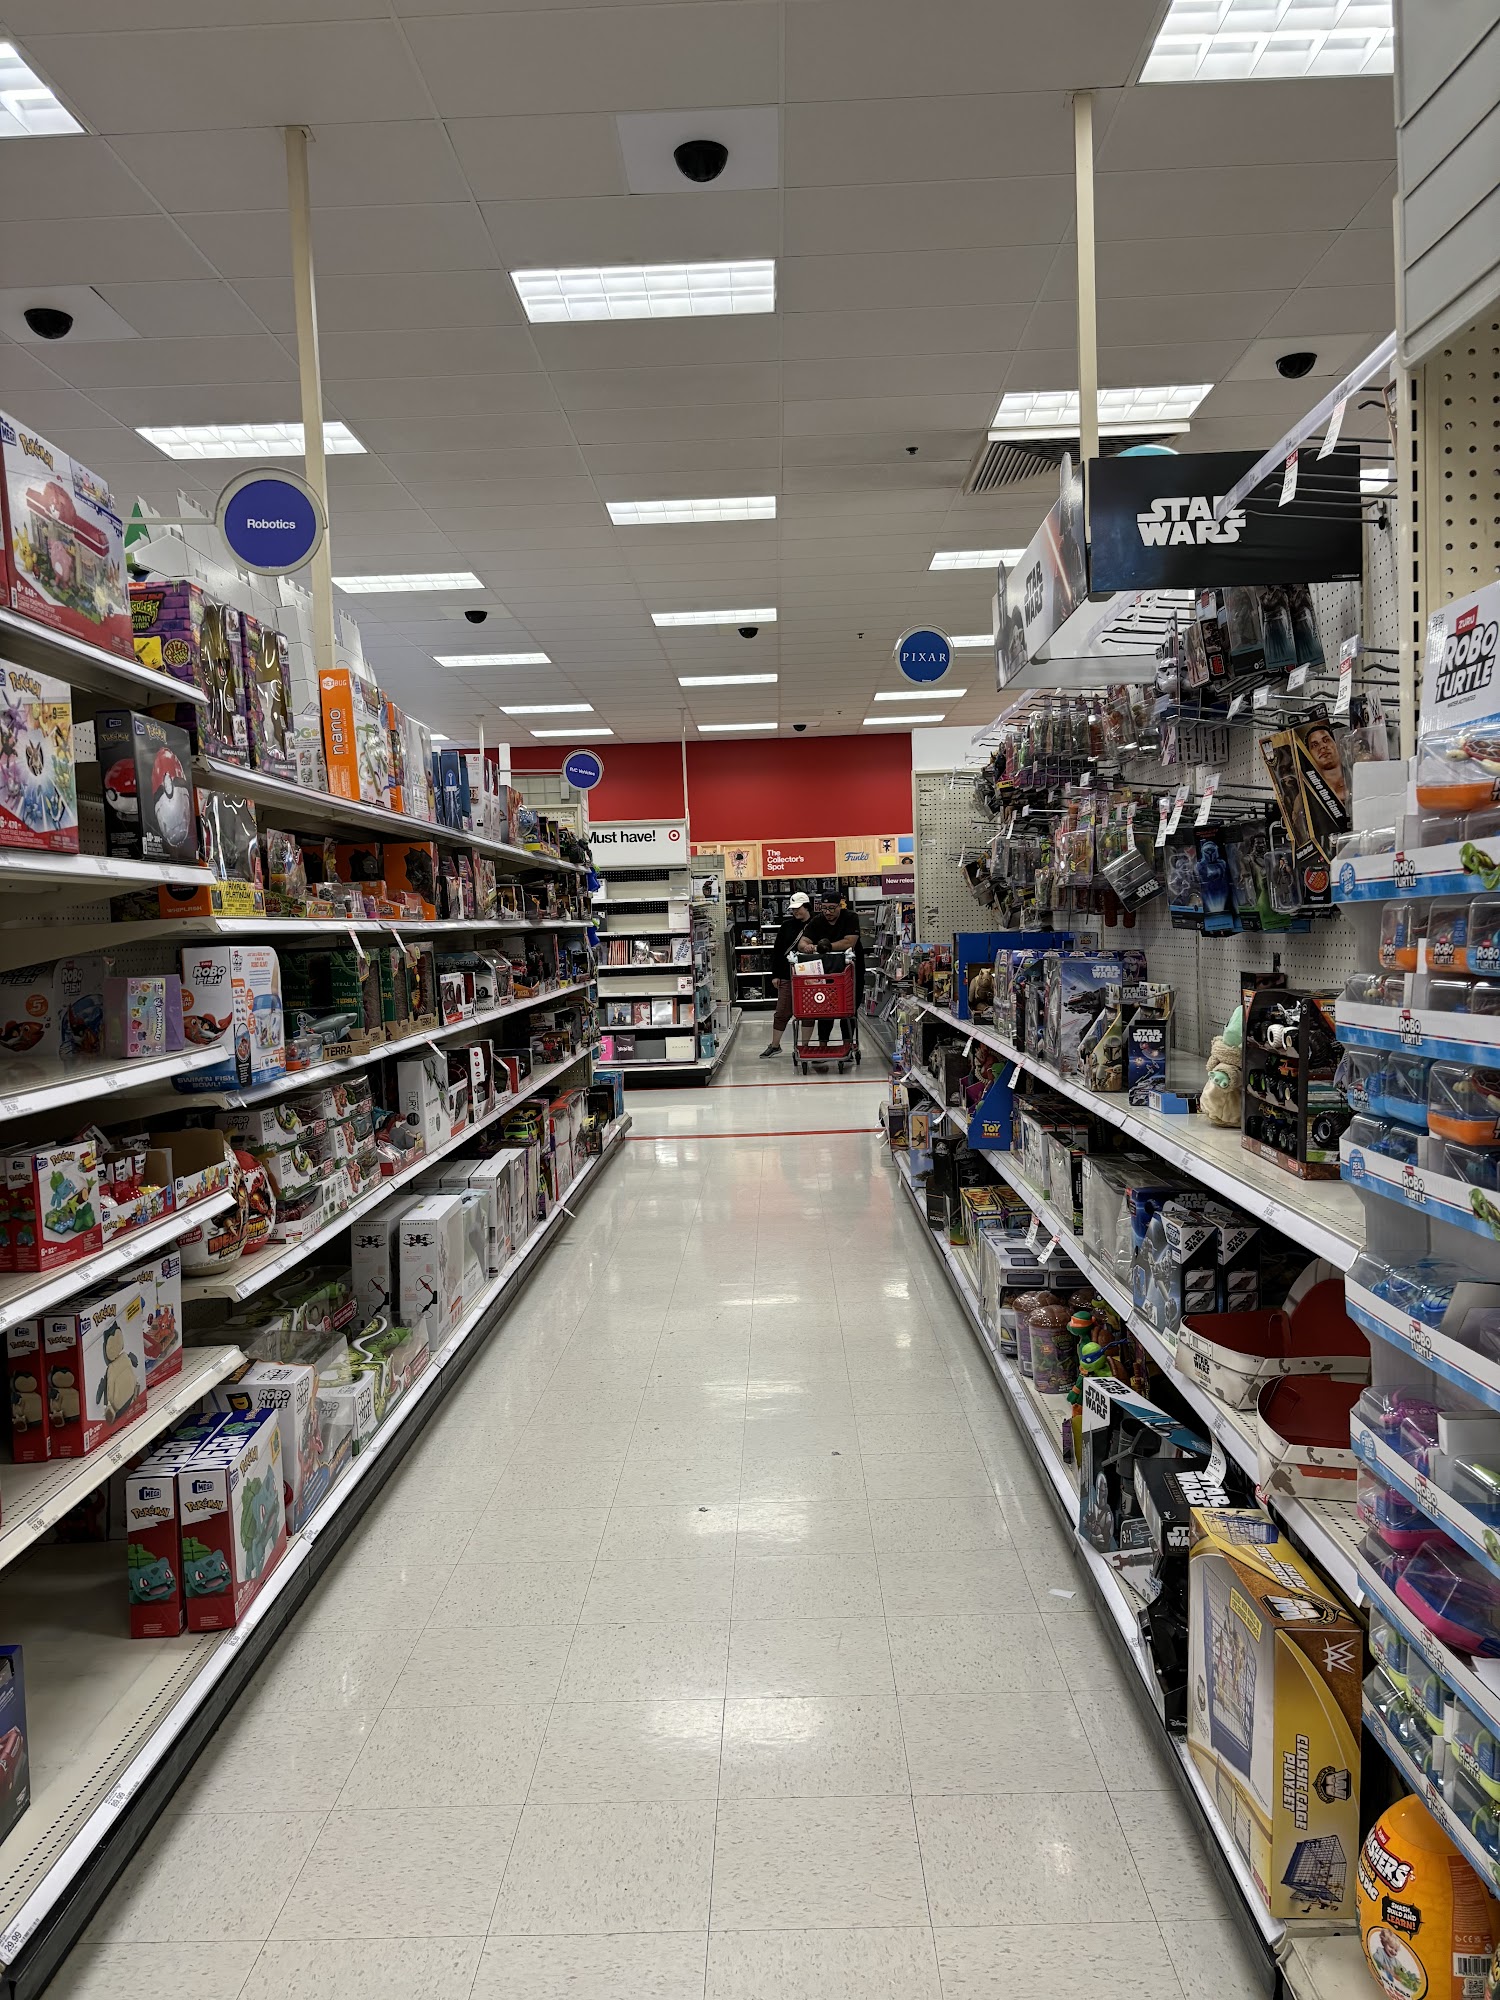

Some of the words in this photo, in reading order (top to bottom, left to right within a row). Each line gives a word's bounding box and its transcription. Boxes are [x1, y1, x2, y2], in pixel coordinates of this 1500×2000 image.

[247, 518, 296, 530] Robotics
[1137, 516, 1246, 546] WARS
[1025, 561, 1043, 597] STAR
[1025, 587, 1043, 628] WARS
[1458, 615, 1475, 629] ZURU
[1440, 621, 1498, 675] ROBO
[903, 652, 946, 662] PIXAR
[9, 672, 42, 699] Pokémon
[1435, 656, 1495, 704] TURTLE
[330, 709, 345, 756] nano
[578, 768, 596, 776] Vehicles
[1306, 770, 1323, 791] Andre
[1318, 788, 1330, 802] the
[1326, 798, 1344, 819] Giant
[588, 831, 617, 844] Must
[620, 830, 656, 843] have!
[767, 855, 805, 864] Collector's
[844, 852, 869, 862] Funko
[767, 863, 785, 871] Spot
[1393, 859, 1416, 876] ROBO
[1137, 878, 1157, 892] STAR
[1393, 874, 1418, 888] TURTLE
[225, 891, 251, 899] PLATINUM
[1137, 882, 1159, 899] WARS
[1434, 943, 1454, 955] ROBO
[1477, 947, 1499, 959] ROBO
[1433, 955, 1454, 964] TURTLE
[62, 968, 83, 982] ROBO
[193, 966, 226, 978] ROBO
[1092, 971, 1121, 979] WARS
[195, 977, 222, 985] FISH
[64, 983, 81, 994] FISH
[154, 1006, 163, 1041] APHMAU
[1400, 1018, 1421, 1033] ROBO
[1133, 1034, 1162, 1043] WARS
[1400, 1032, 1422, 1045] TURTLE
[324, 1045, 352, 1057] TERRA
[1353, 1090, 1368, 1100] ROBO
[982, 1123, 1001, 1133] TOY
[50, 1151, 75, 1166] Pokémon
[1402, 1172, 1425, 1191] ROBO
[1176, 1193, 1208, 1202] STAR
[1403, 1188, 1427, 1204] TURTLE
[1185, 1230, 1204, 1248] STAR
[1227, 1230, 1246, 1248] STAR
[93, 1304, 117, 1327] Pokémon
[1409, 1326, 1431, 1348] ROBO
[1410, 1341, 1433, 1362] TURTLE
[1194, 1354, 1209, 1367] STAR
[1194, 1361, 1210, 1374] WARS
[1093, 1378, 1122, 1395] WARS
[1102, 1378, 1130, 1394] STAR
[258, 1389, 291, 1401] ROBO
[1085, 1386, 1108, 1405] STAR
[259, 1399, 288, 1409] ALIVE
[1085, 1395, 1108, 1420] WARS
[145, 1489, 161, 1498] MEGA
[198, 1482, 213, 1491] MEGA
[1415, 1480, 1438, 1507] ROBO
[131, 1505, 170, 1519] Pokémon
[185, 1498, 223, 1512] Pokémon
[1417, 1496, 1440, 1518] TURTLE
[1167, 1526, 1189, 1537] ST
[1167, 1536, 1189, 1547] WA
[1422, 1636, 1444, 1663] ROBO
[1425, 1650, 1447, 1676] TURTLE
[1295, 1734, 1309, 1790] CLASSIC
[1459, 1748, 1480, 1771] ROBO
[1283, 1751, 1296, 1813] PLAYSET
[1295, 1792, 1309, 1831] CAGE
[1387, 1907, 1403, 1918] BUILD
[1403, 1911, 1417, 1922] AND
[1391, 1902, 1412, 1914] SMASH,
[1387, 1914, 1416, 1930] LEARN!
[4, 1931, 22, 1952] 29.99
